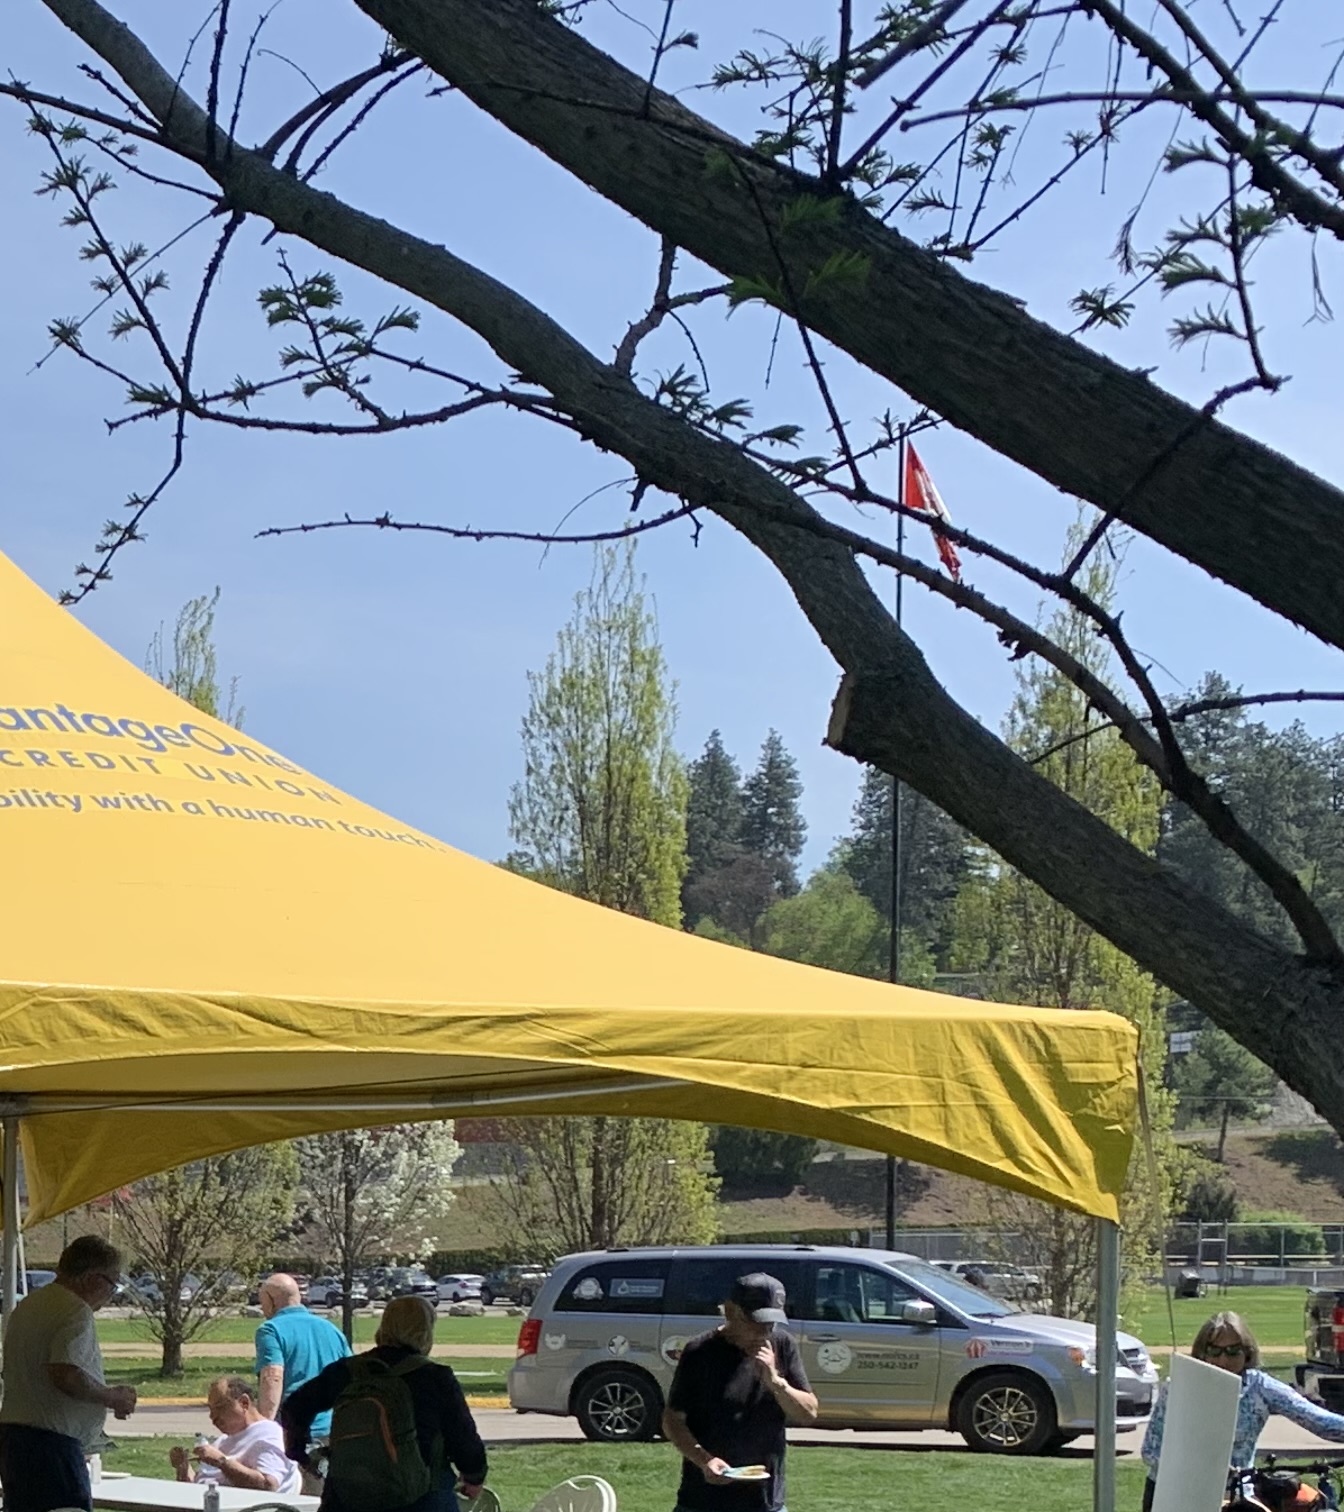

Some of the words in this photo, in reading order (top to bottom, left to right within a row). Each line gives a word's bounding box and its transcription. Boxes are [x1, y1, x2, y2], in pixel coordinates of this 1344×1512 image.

[184, 762, 342, 806] UNION
[89, 791, 175, 813] with
[181, 800, 206, 816] a
[206, 799, 337, 831] human
